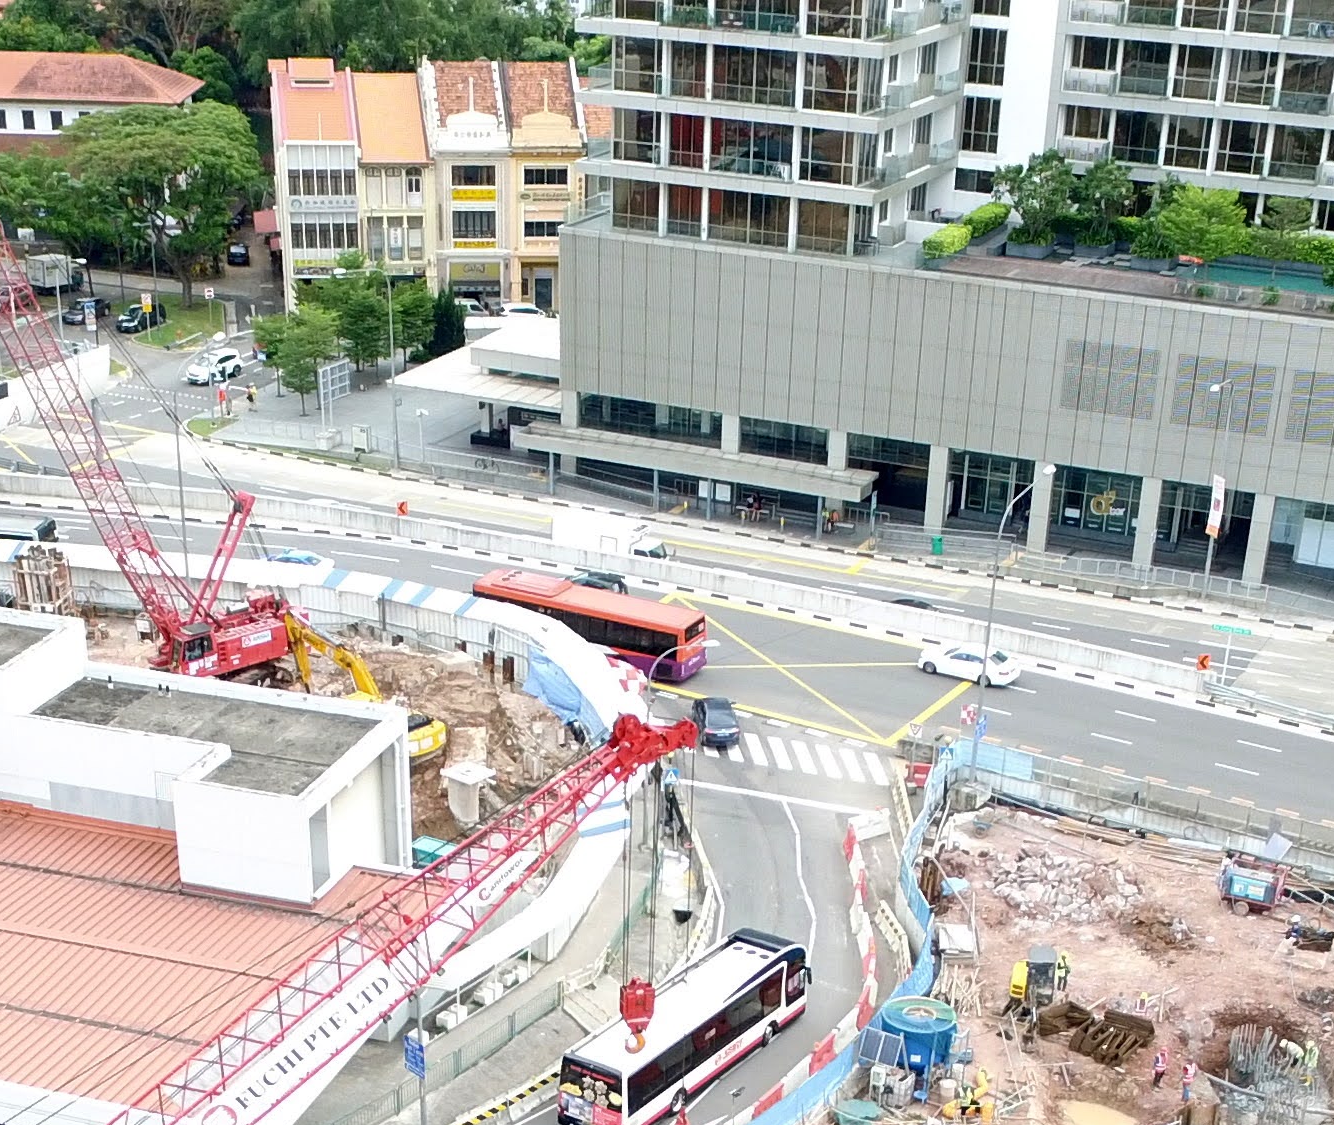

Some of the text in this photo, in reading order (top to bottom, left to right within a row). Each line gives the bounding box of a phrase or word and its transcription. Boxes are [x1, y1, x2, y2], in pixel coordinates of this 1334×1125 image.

[234, 976, 390, 1110] FUCHI PTE LTD
